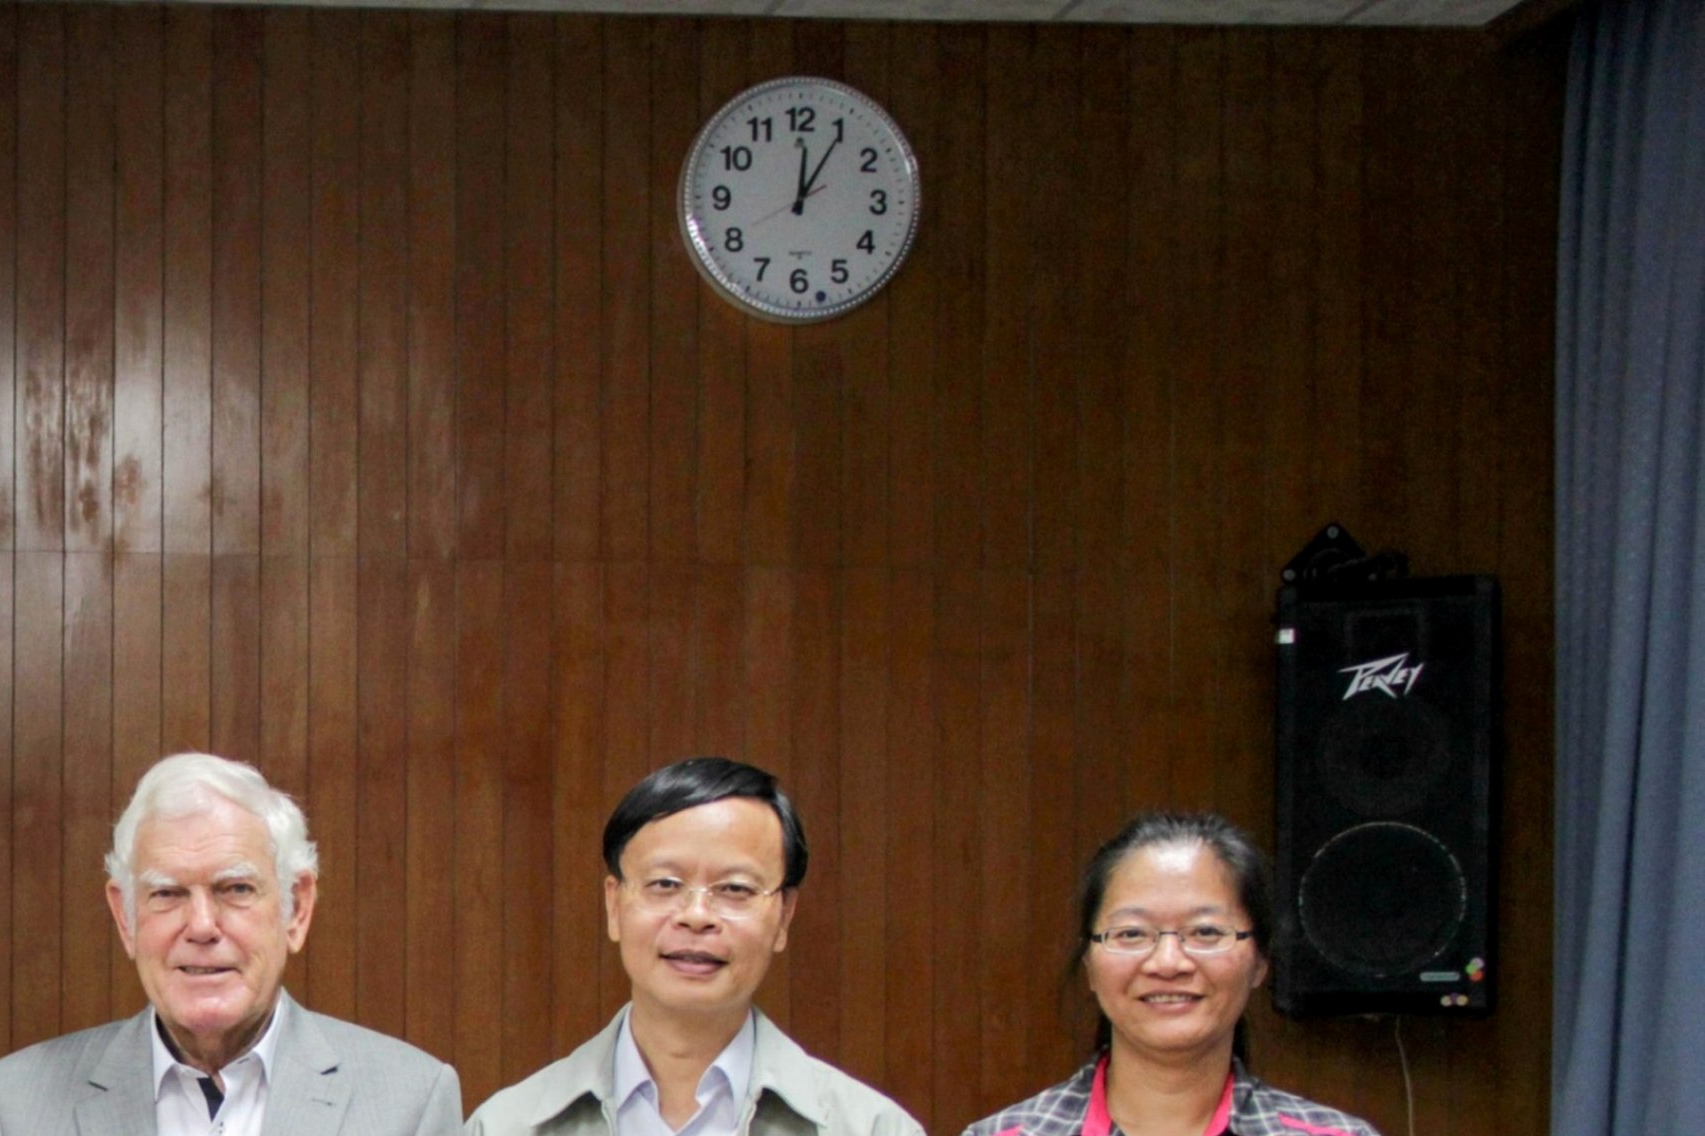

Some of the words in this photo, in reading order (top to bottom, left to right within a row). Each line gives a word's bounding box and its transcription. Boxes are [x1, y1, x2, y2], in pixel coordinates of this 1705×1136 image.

[747, 117, 772, 143] 11
[785, 107, 816, 132] 12
[832, 118, 843, 143] 1
[720, 146, 753, 171] 10
[860, 148, 878, 173] 2
[712, 185, 731, 211] 9
[869, 189, 887, 215] 3
[724, 227, 743, 252] 8
[856, 230, 875, 254] 4
[754, 257, 771, 281] 7
[789, 269, 809, 294] 6
[830, 259, 849, 283] 5
